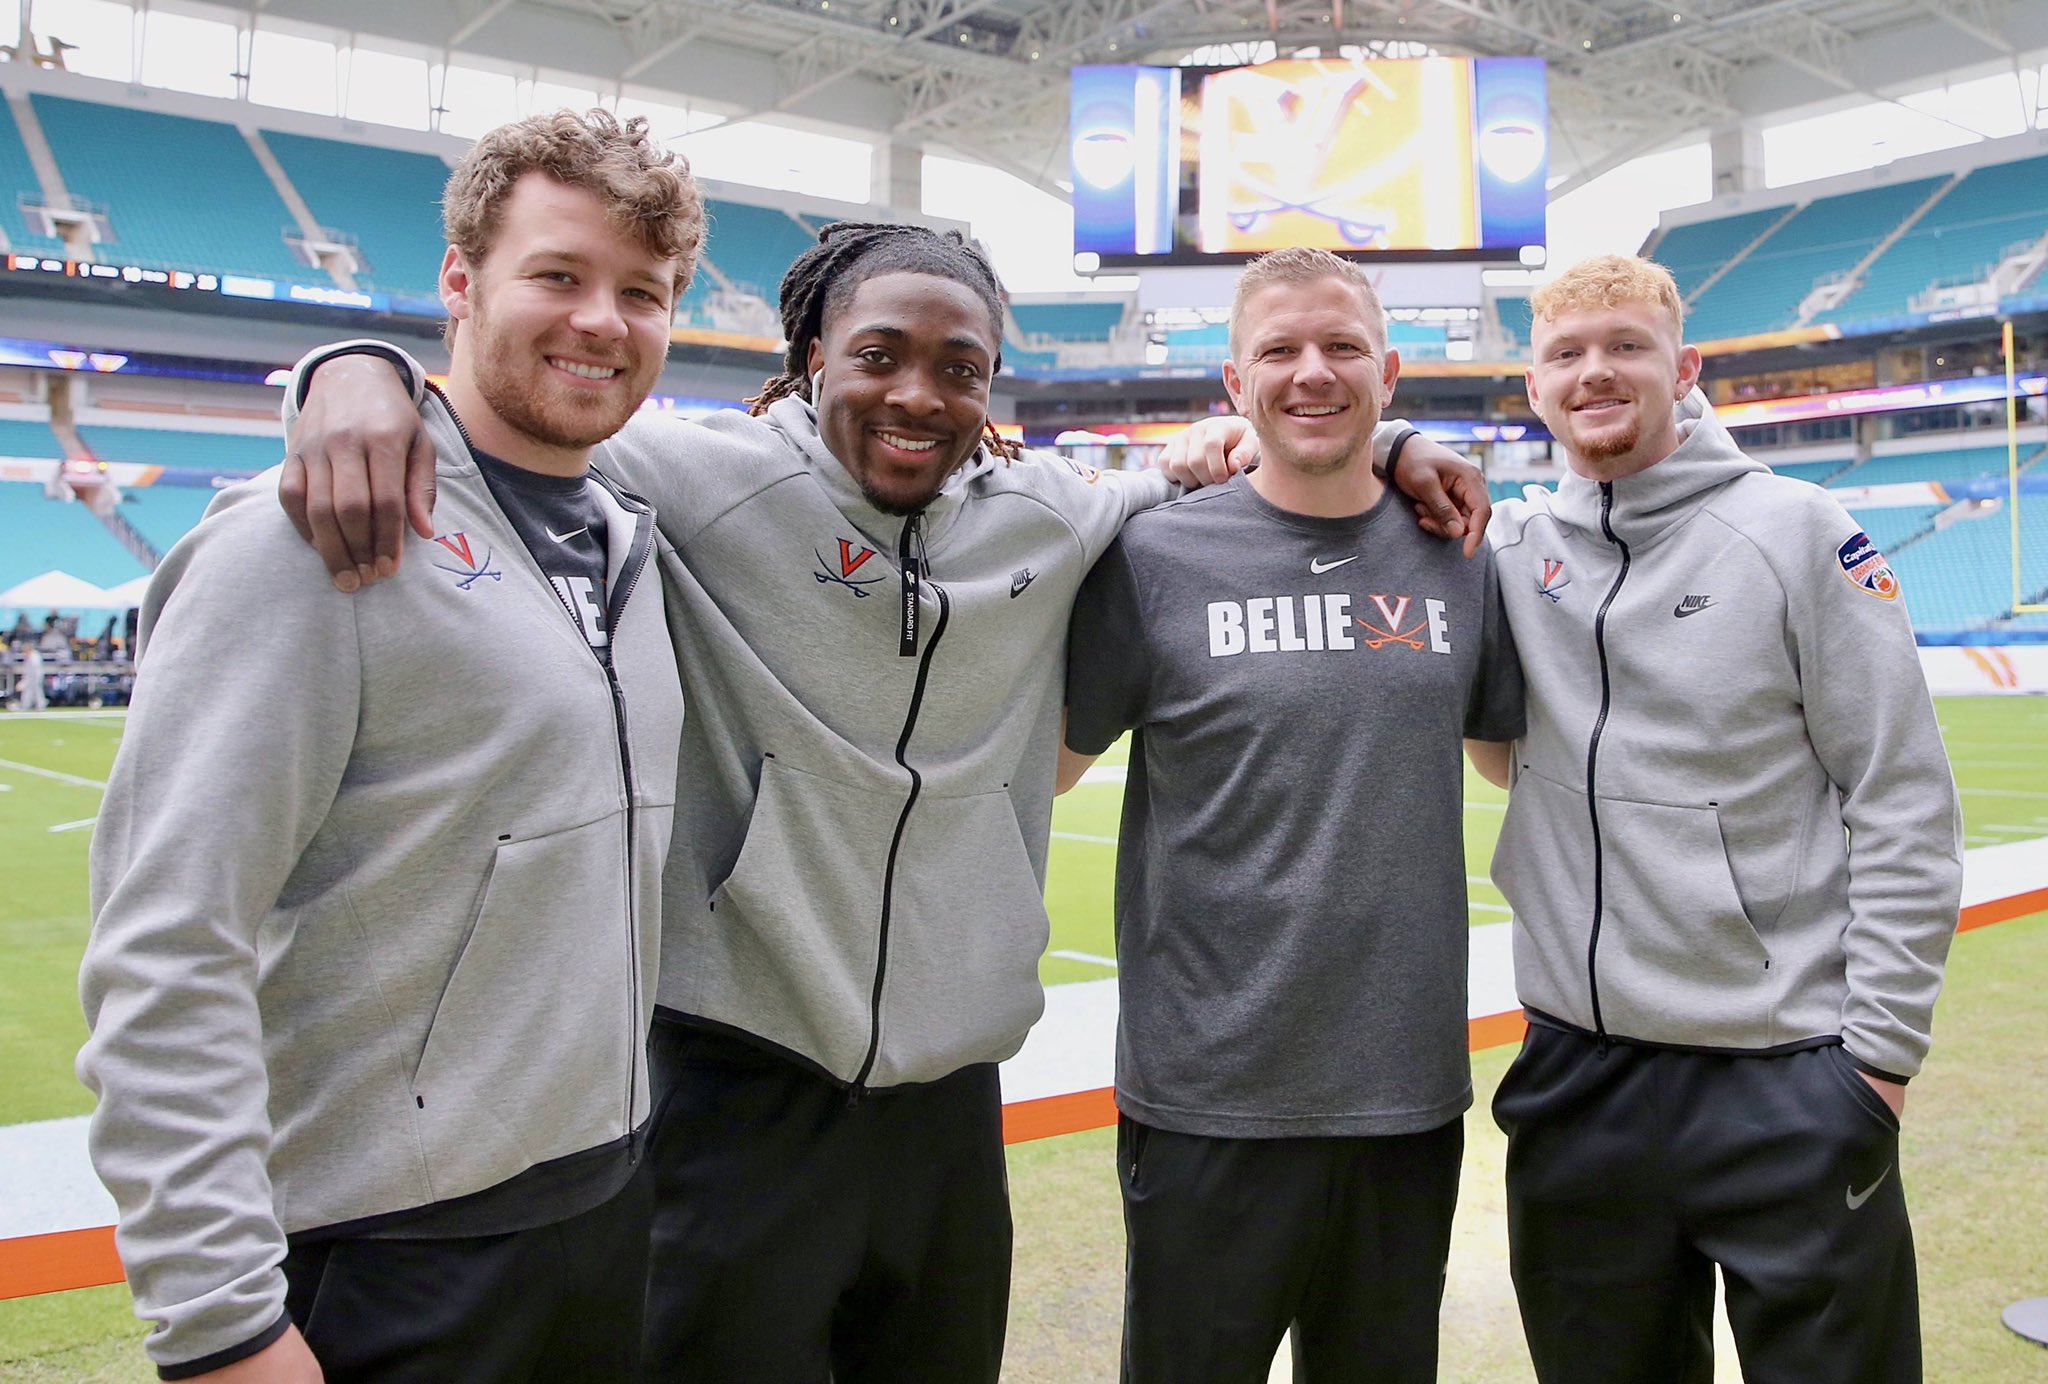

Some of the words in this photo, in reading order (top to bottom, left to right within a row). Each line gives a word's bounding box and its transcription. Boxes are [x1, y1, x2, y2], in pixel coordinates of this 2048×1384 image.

[1681, 595, 1711, 608] NIKE
[906, 592, 914, 629] STANDARD
[906, 631, 914, 641] FIT
